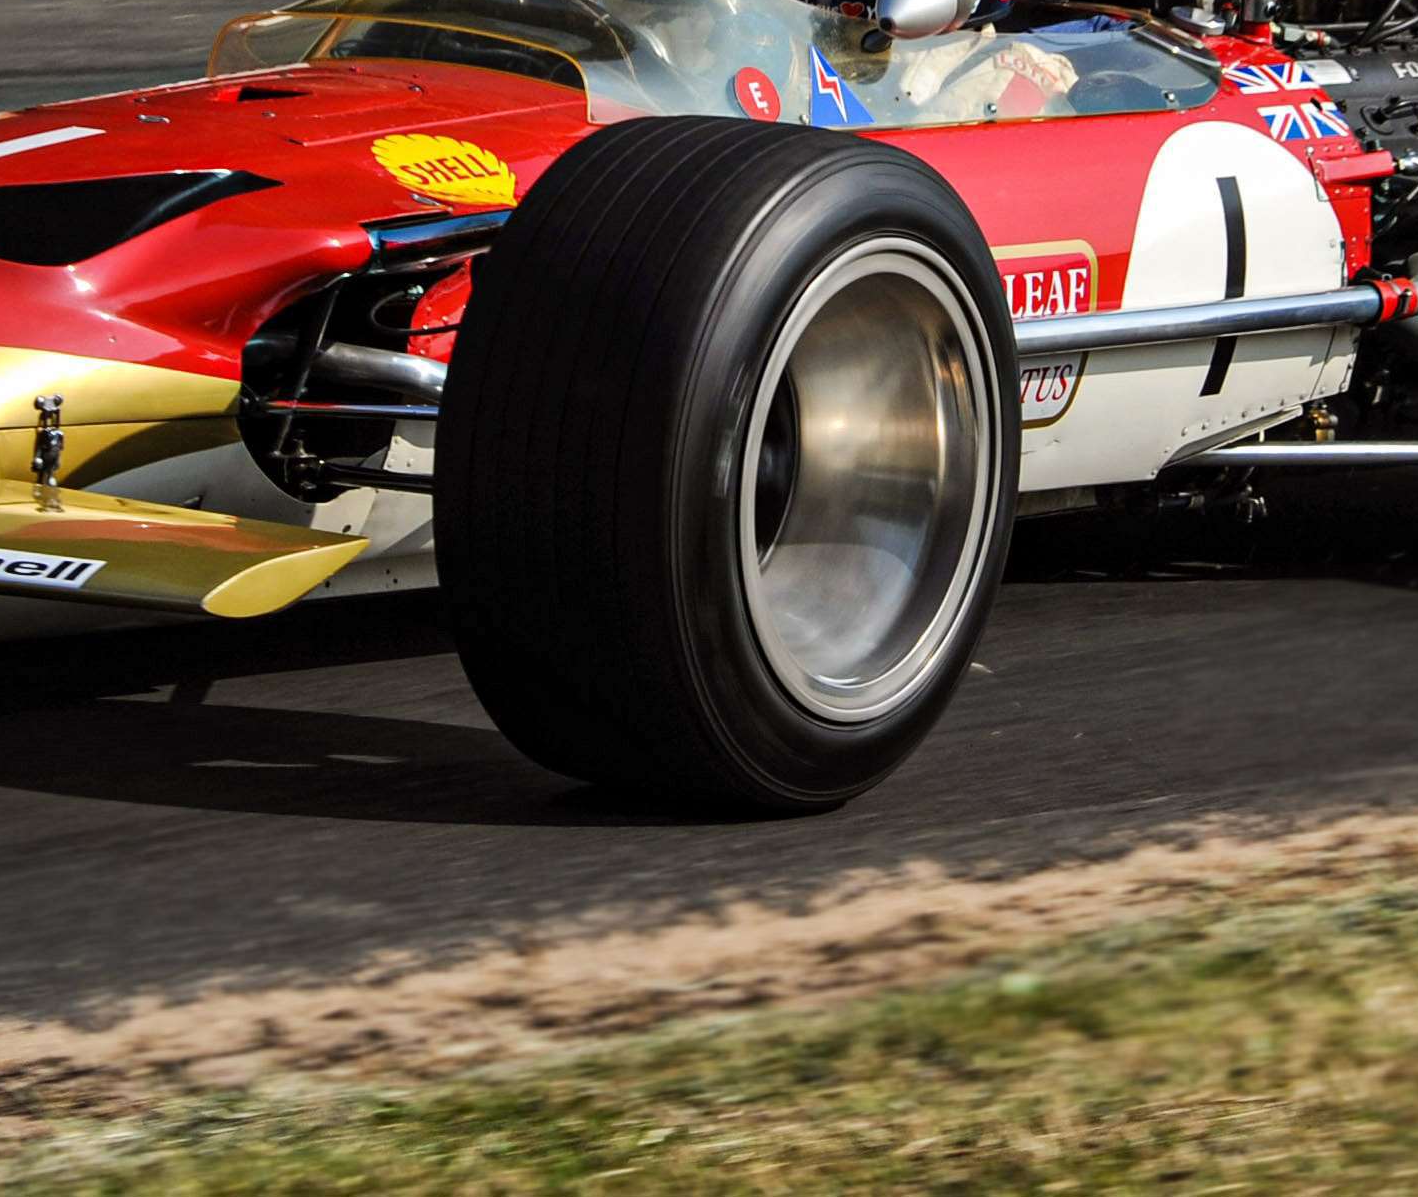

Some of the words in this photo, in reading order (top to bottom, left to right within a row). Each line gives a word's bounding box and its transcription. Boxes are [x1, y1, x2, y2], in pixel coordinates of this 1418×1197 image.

[398, 150, 498, 185] SHELL
[1003, 267, 1088, 321] LEAF
[1198, 176, 1248, 398] 1
[1019, 364, 1074, 404] TUS
